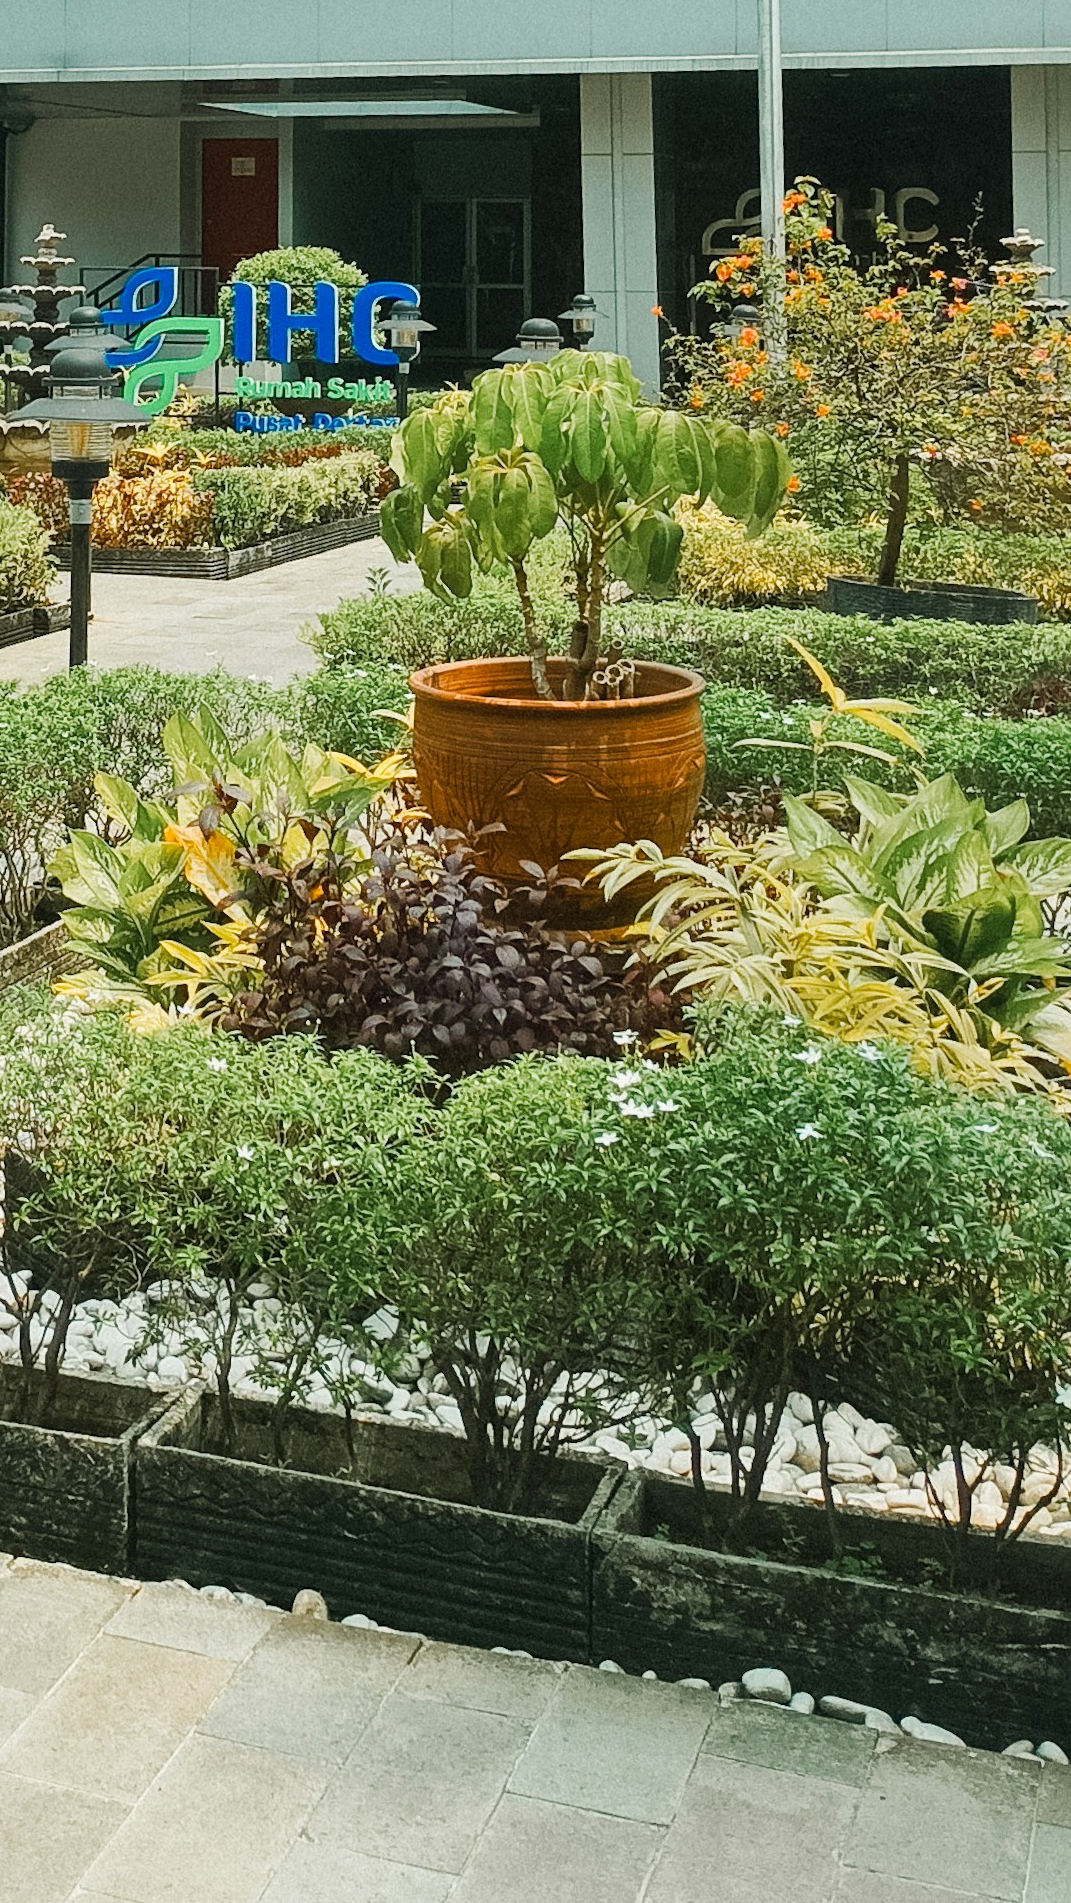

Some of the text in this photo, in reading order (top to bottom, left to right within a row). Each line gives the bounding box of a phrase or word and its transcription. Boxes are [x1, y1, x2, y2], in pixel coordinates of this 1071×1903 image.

[232, 281, 421, 366] IHC
[235, 376, 397, 401] Rumah Sakit
[234, 410, 306, 433] Pusat
